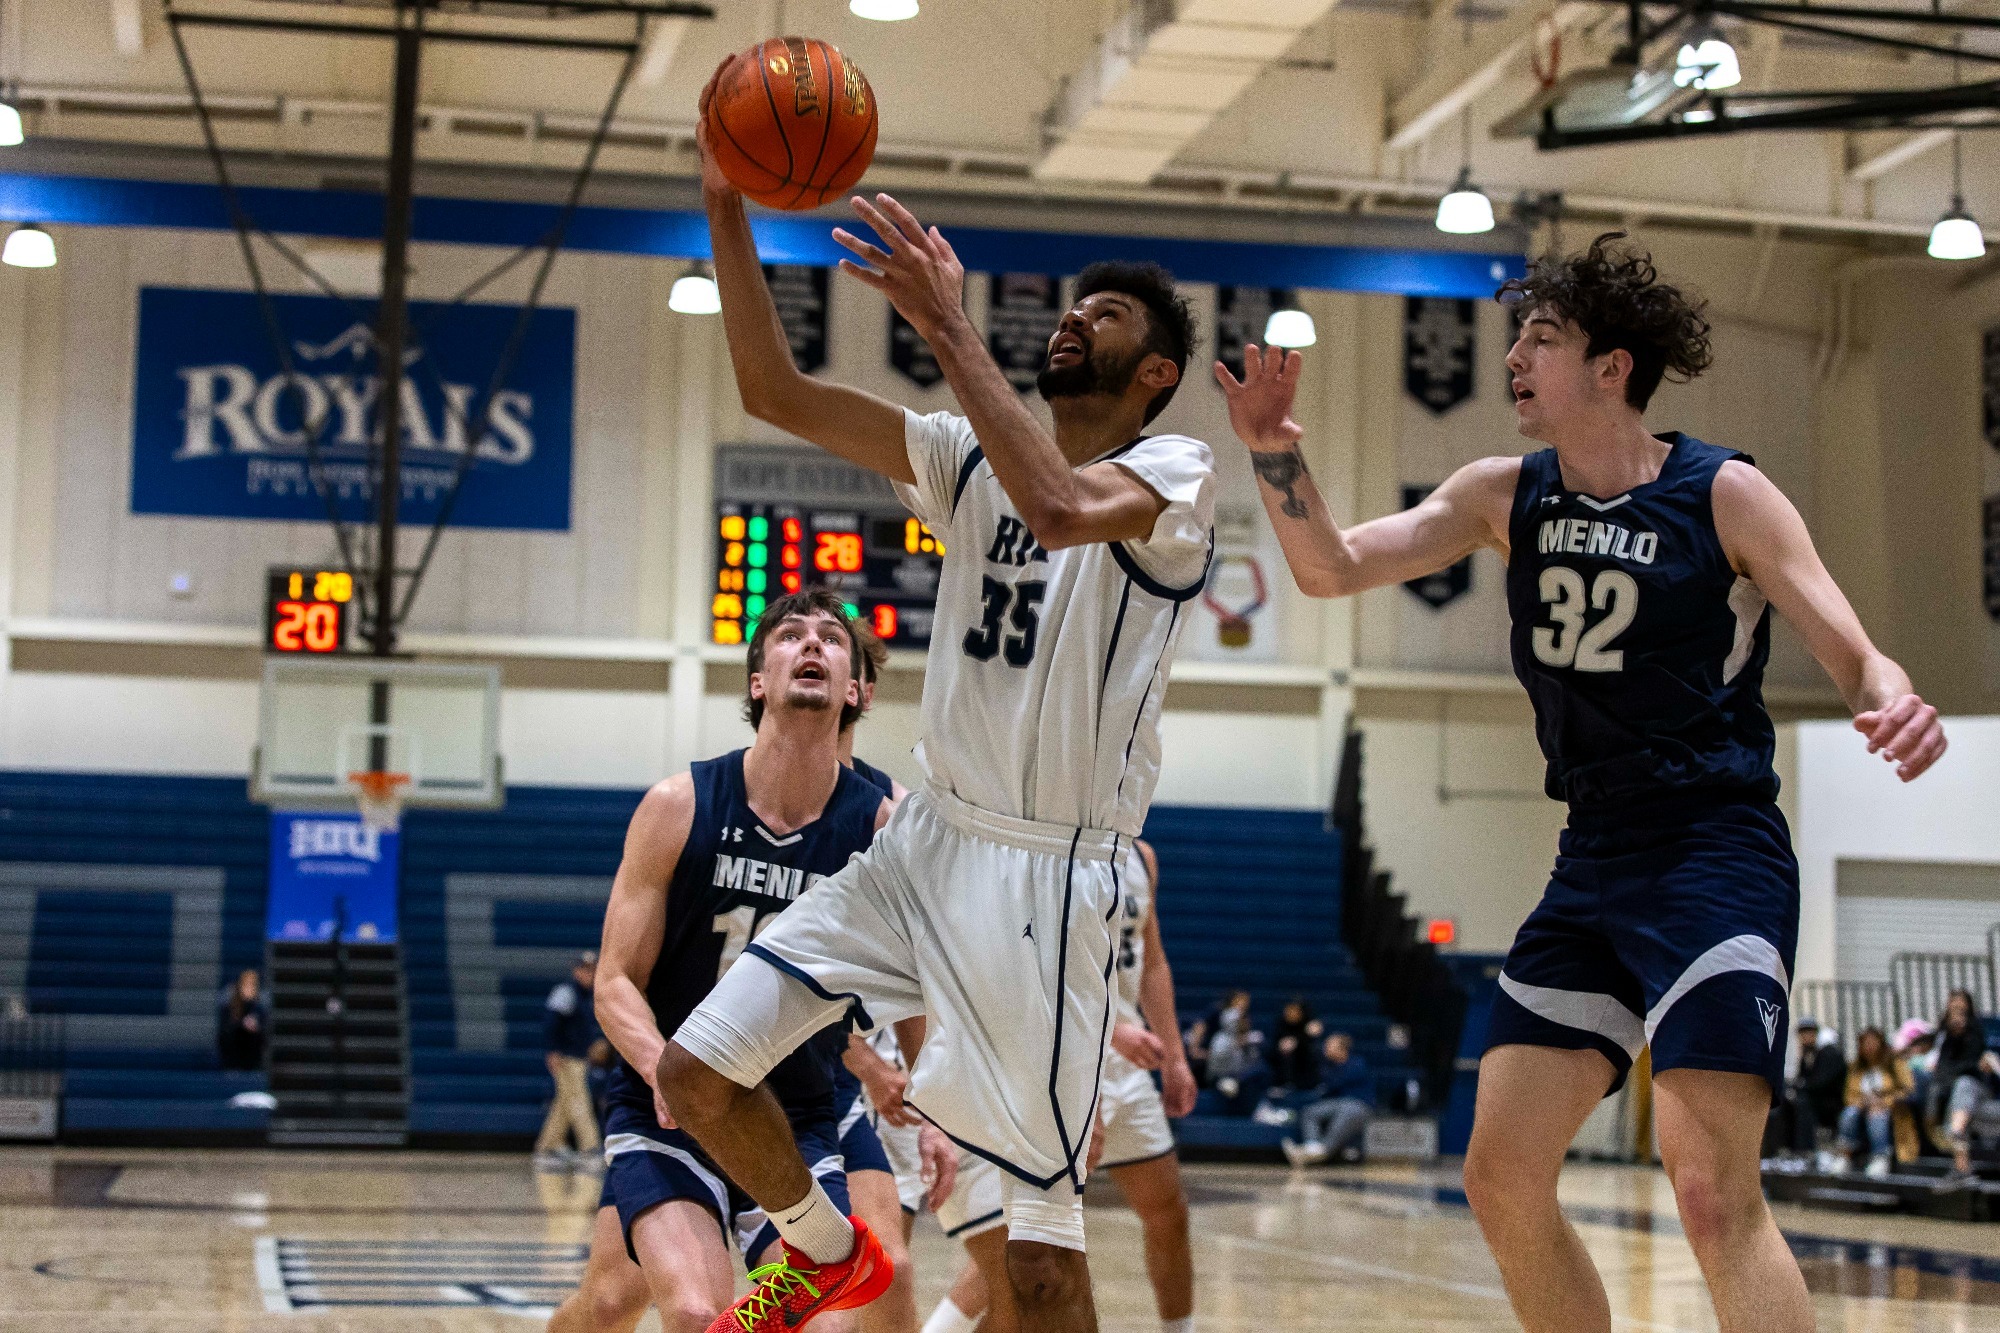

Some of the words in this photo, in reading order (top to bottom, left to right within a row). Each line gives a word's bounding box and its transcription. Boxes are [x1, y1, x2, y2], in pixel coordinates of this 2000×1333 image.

[171, 362, 535, 467] ROYALS
[814, 532, 863, 573] 28
[984, 514, 1050, 567] HI
[1538, 518, 1659, 565] MENLO
[274, 601, 339, 653] 20
[962, 573, 1047, 669] 35
[1531, 565, 1639, 673] 32
[711, 904, 783, 984] 1
